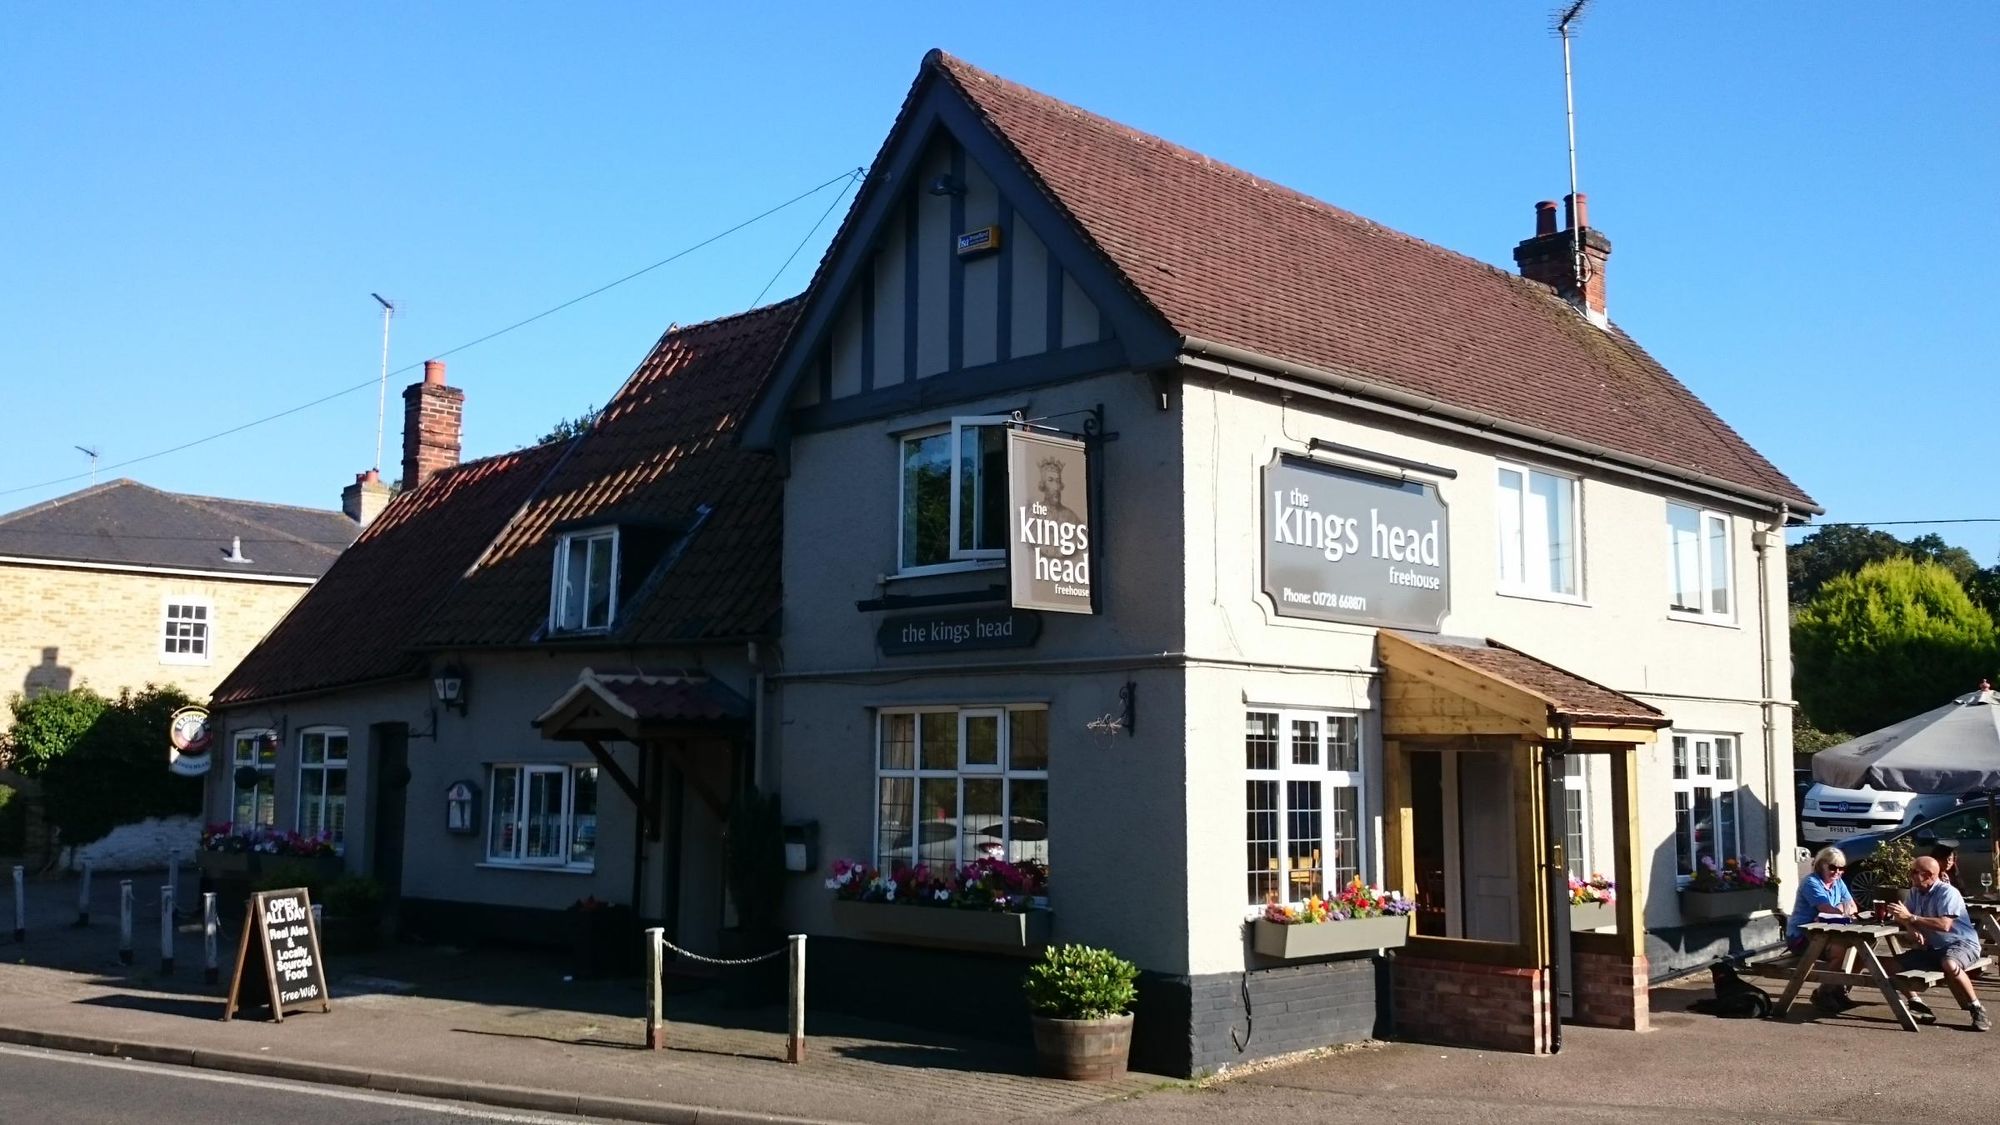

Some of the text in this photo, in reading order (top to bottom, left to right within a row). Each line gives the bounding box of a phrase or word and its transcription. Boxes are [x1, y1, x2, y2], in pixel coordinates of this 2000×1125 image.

[1290, 488, 1310, 508] the
[1032, 501, 1048, 516] the
[1020, 506, 1089, 556] kings
[1274, 490, 1440, 567] kings head
[1035, 547, 1090, 585] head
[1389, 567, 1441, 590] freehouse
[1055, 584, 1090, 598] freehouse
[1283, 587, 1311, 605] Phone:
[1312, 591, 1338, 608] 01728
[902, 615, 1013, 644] the kings head
[270, 897, 298, 912] OPEN
[266, 907, 306, 924] ALL DAY
[270, 925, 308, 940] Real Ales
[287, 937, 295, 948] &
[277, 946, 308, 961] Locally
[277, 955, 313, 972] Sourced
[285, 967, 308, 981] Food
[281, 990, 299, 1003] Free
